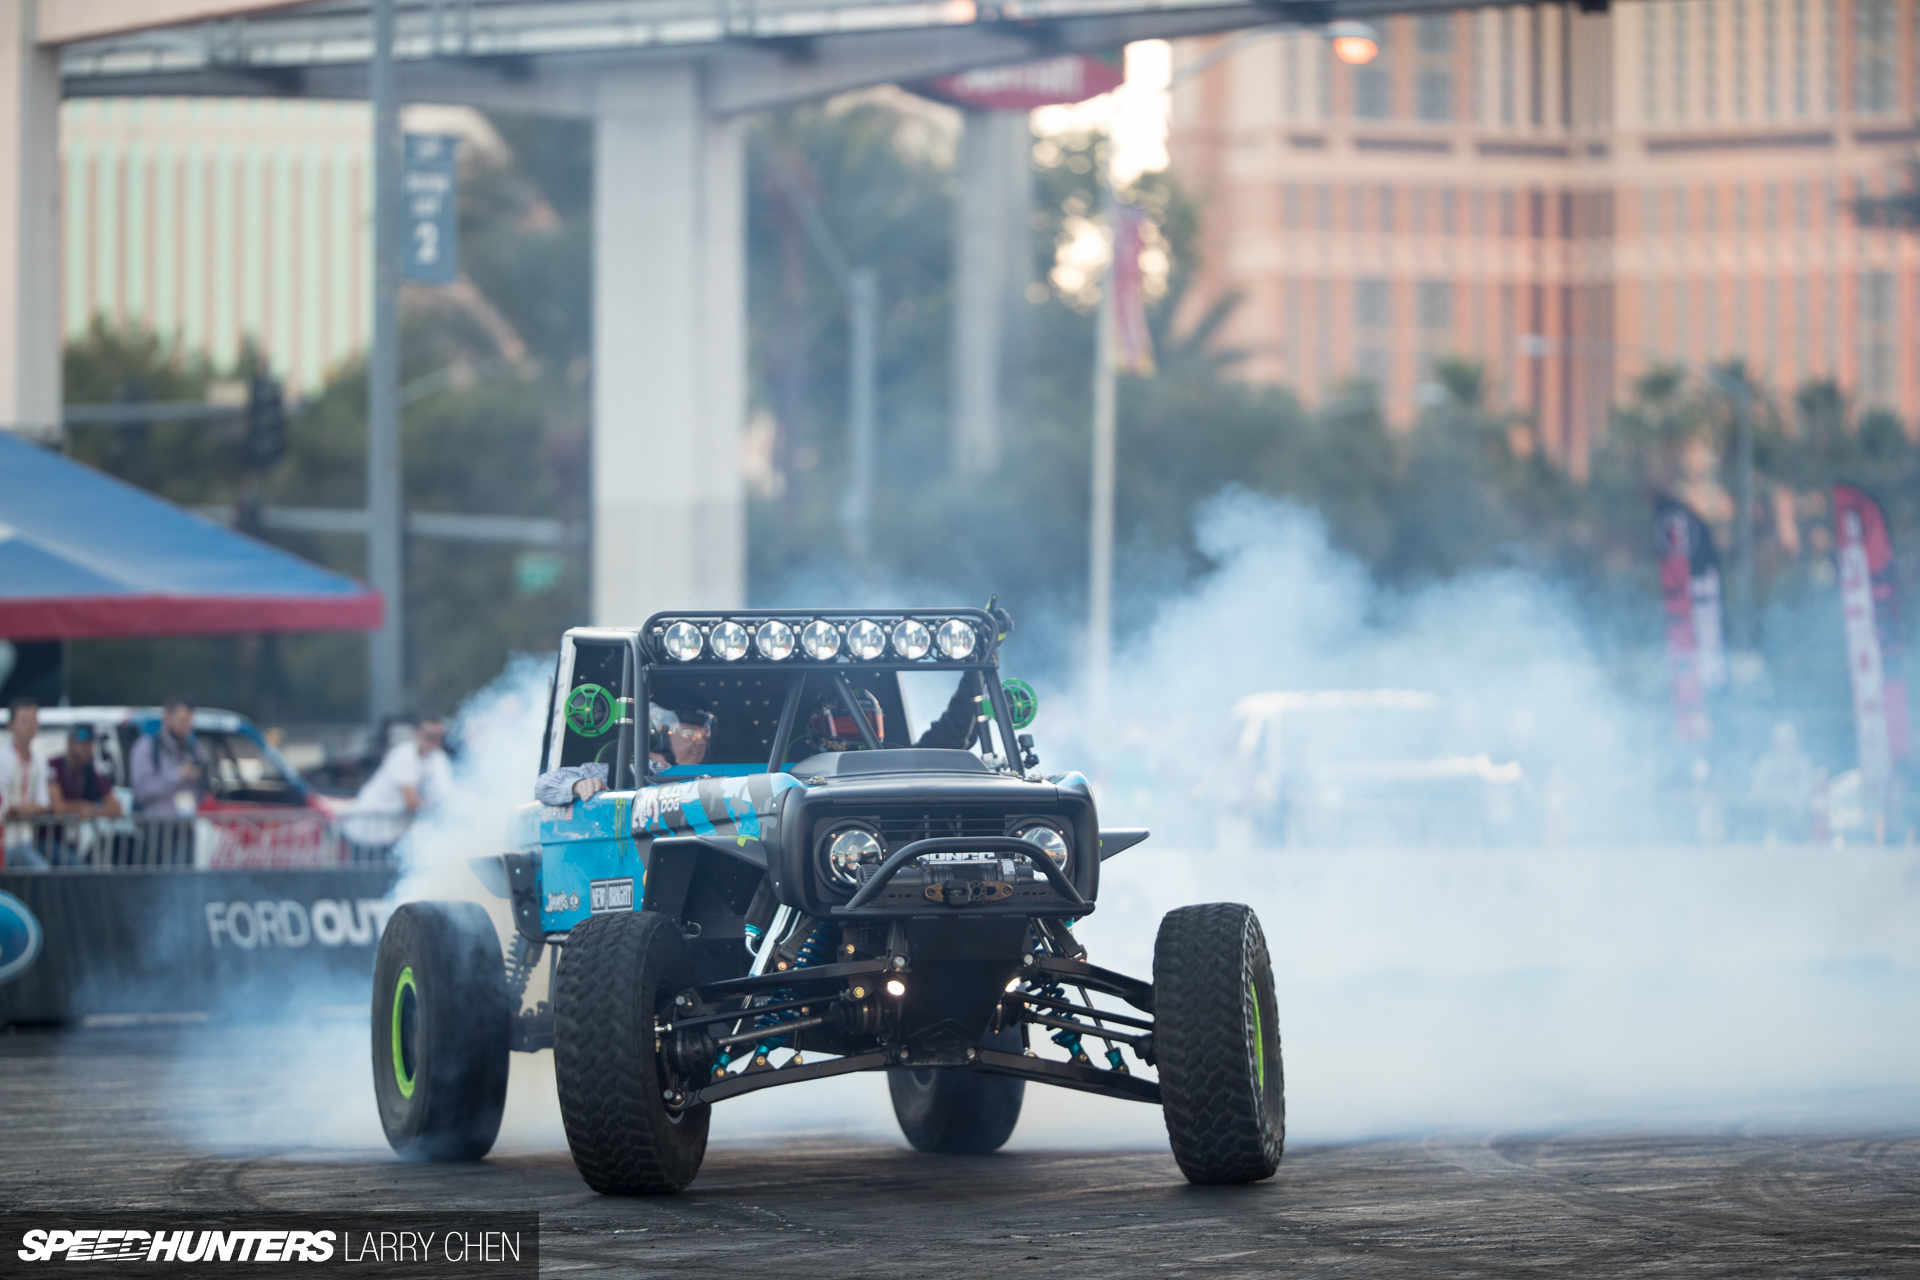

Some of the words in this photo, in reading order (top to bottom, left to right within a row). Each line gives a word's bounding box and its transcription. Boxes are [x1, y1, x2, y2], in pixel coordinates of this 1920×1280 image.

[661, 797, 680, 813] DOG
[592, 886, 606, 909] NEW
[205, 900, 311, 949] FORD
